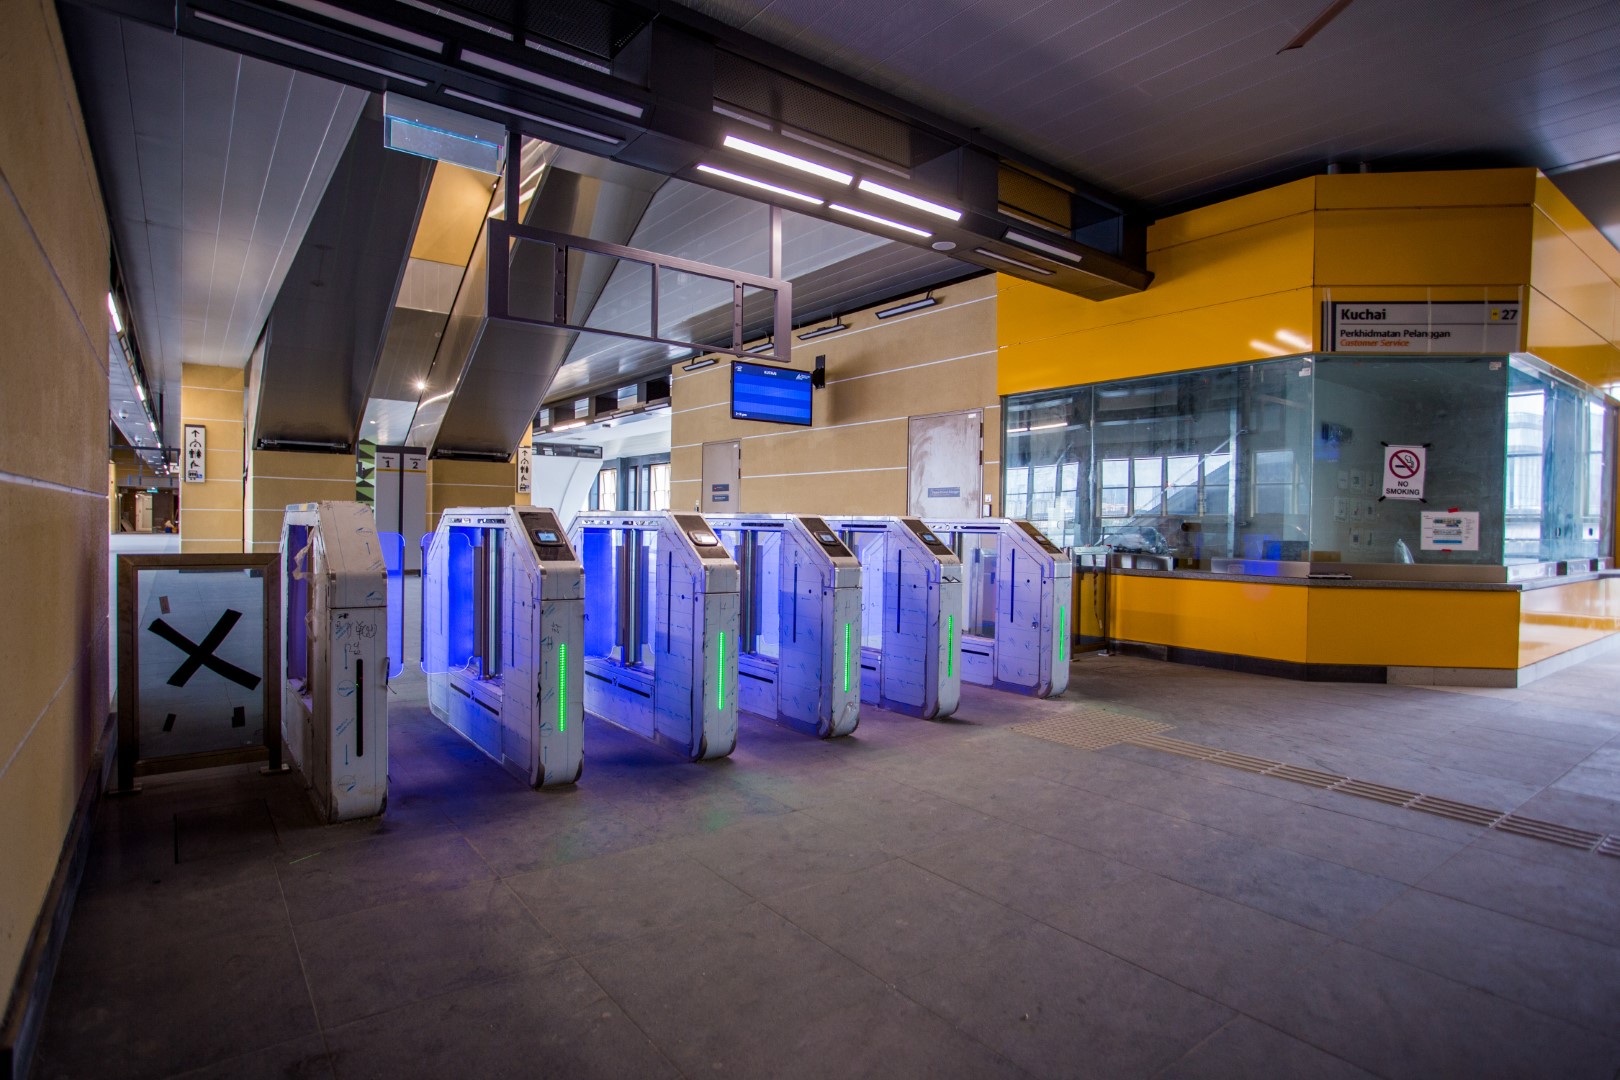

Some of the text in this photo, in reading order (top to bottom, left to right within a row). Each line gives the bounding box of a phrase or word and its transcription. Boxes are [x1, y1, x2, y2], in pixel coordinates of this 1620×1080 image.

[1341, 308, 1387, 321] Kuchai
[1501, 309, 1518, 320] 27
[1340, 329, 1401, 338] Perkhidmatan
[385, 460, 391, 468] 1
[412, 461, 418, 469] 2
